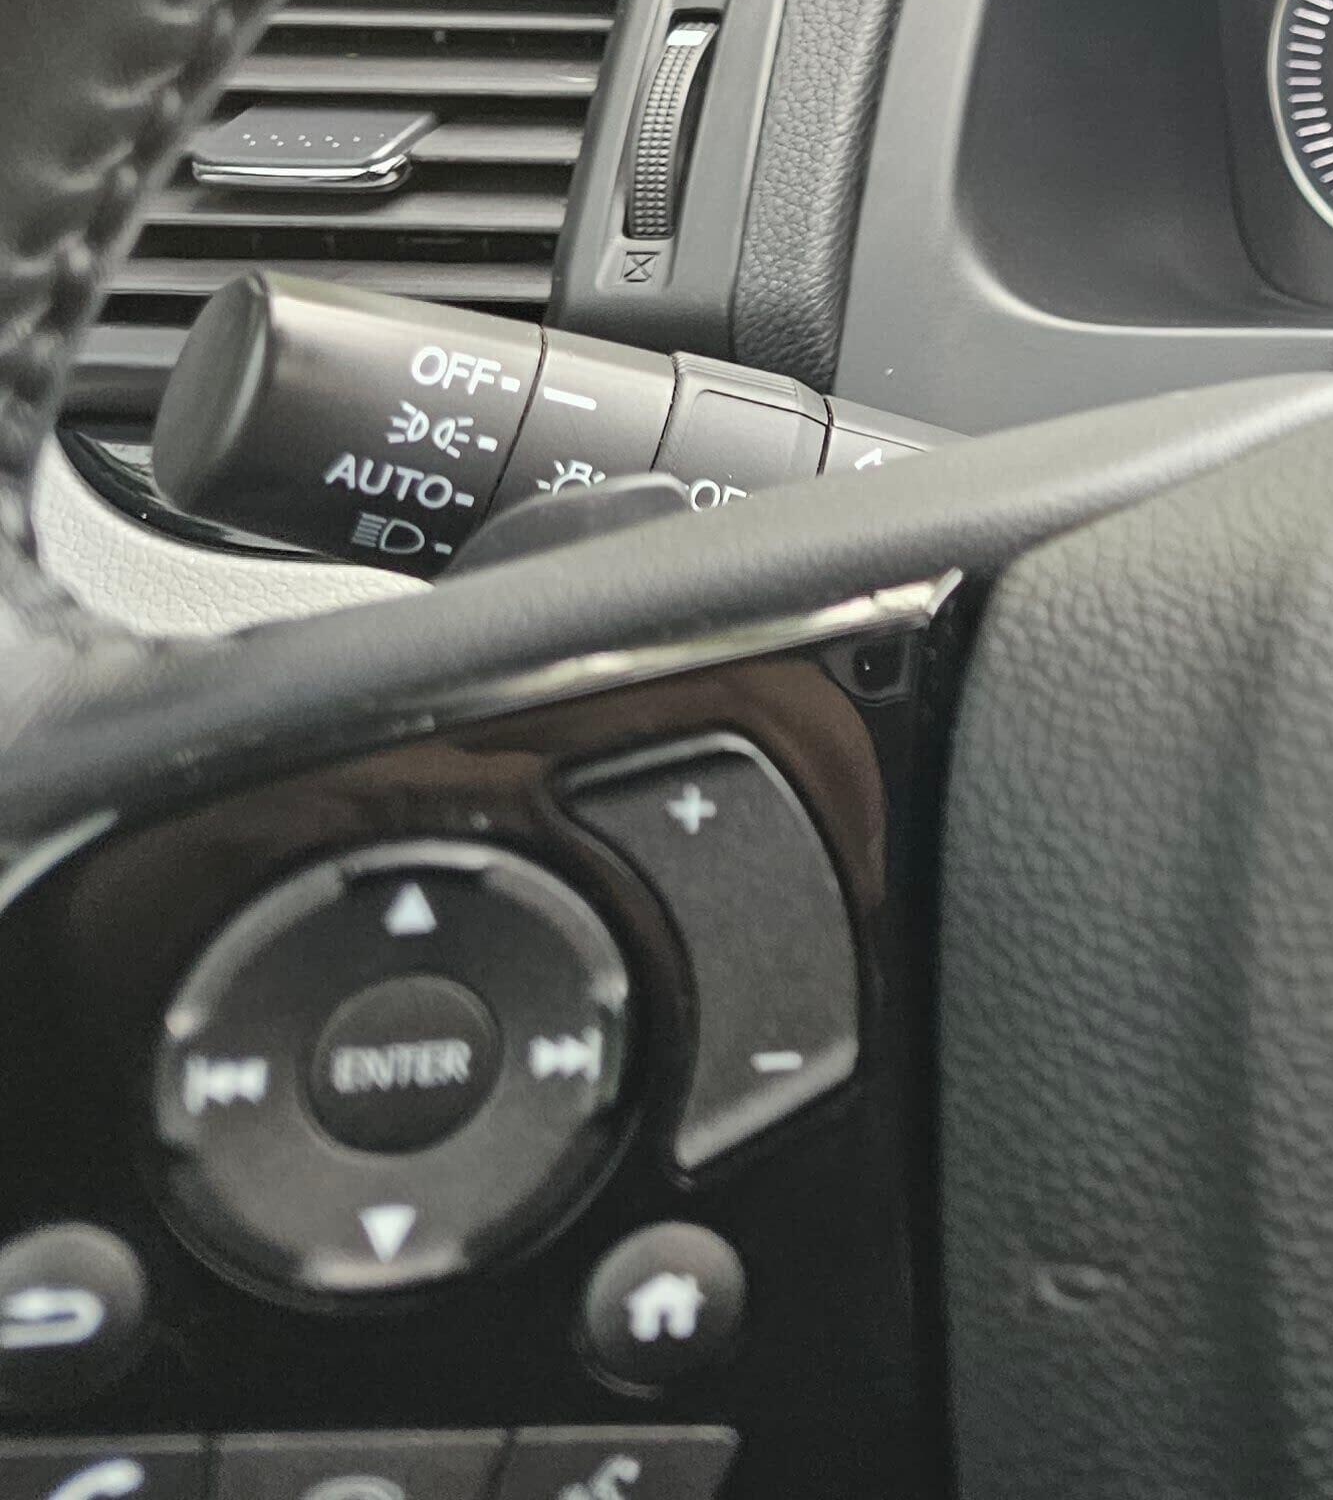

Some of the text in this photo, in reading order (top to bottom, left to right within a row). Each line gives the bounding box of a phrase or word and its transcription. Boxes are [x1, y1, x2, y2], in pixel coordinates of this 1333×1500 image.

[412, 346, 501, 394] OFF
[325, 453, 453, 509] AUTO
[330, 1039, 472, 1094] ENTER
